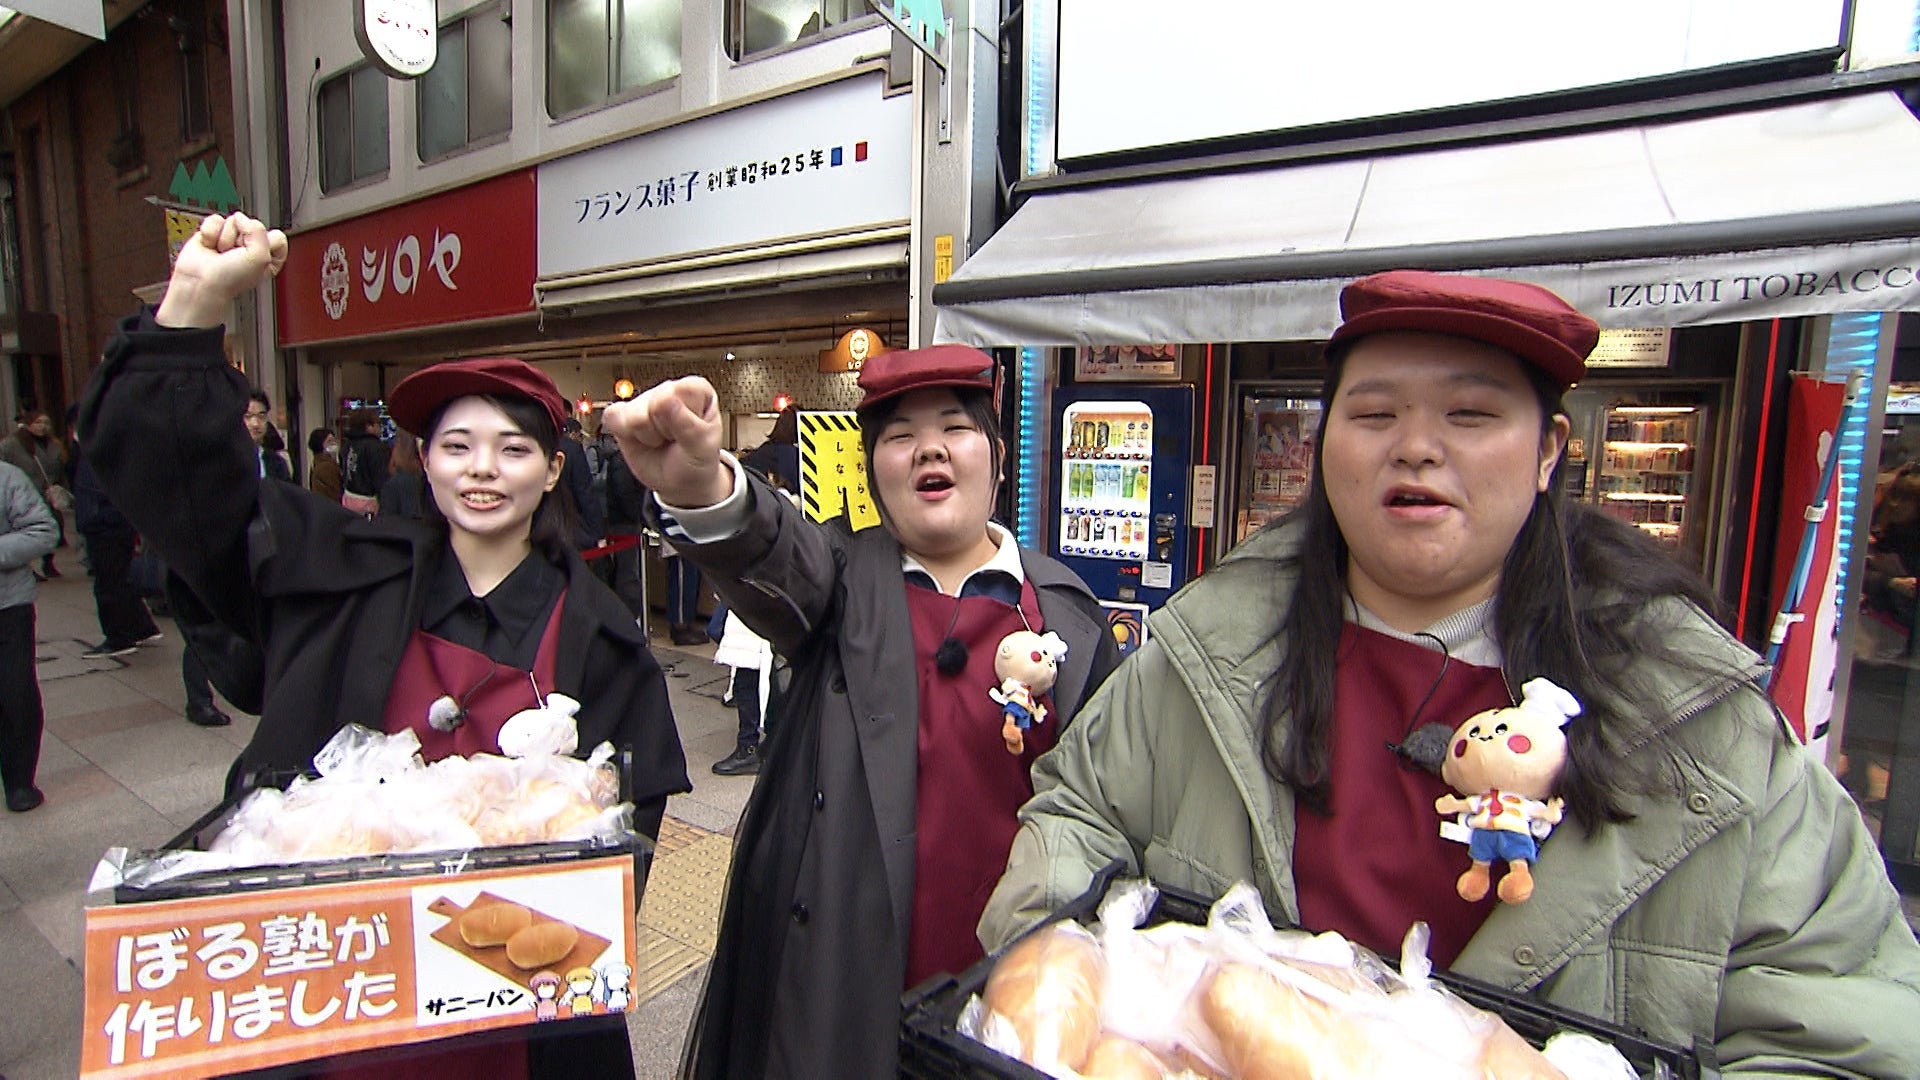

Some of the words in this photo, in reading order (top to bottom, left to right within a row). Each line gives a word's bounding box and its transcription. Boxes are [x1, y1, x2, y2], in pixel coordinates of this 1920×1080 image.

[575, 170, 700, 223] フランス菓子
[706, 149, 825, 192] 創業昭和25年
[361, 225, 462, 303] シロヤ
[1606, 279, 1722, 308] IZUMI
[1733, 265, 1920, 300] TOBACC
[115, 911, 391, 993] ぼる塾が
[103, 971, 398, 1065] 作りました
[425, 988, 525, 1017] サニーパン
